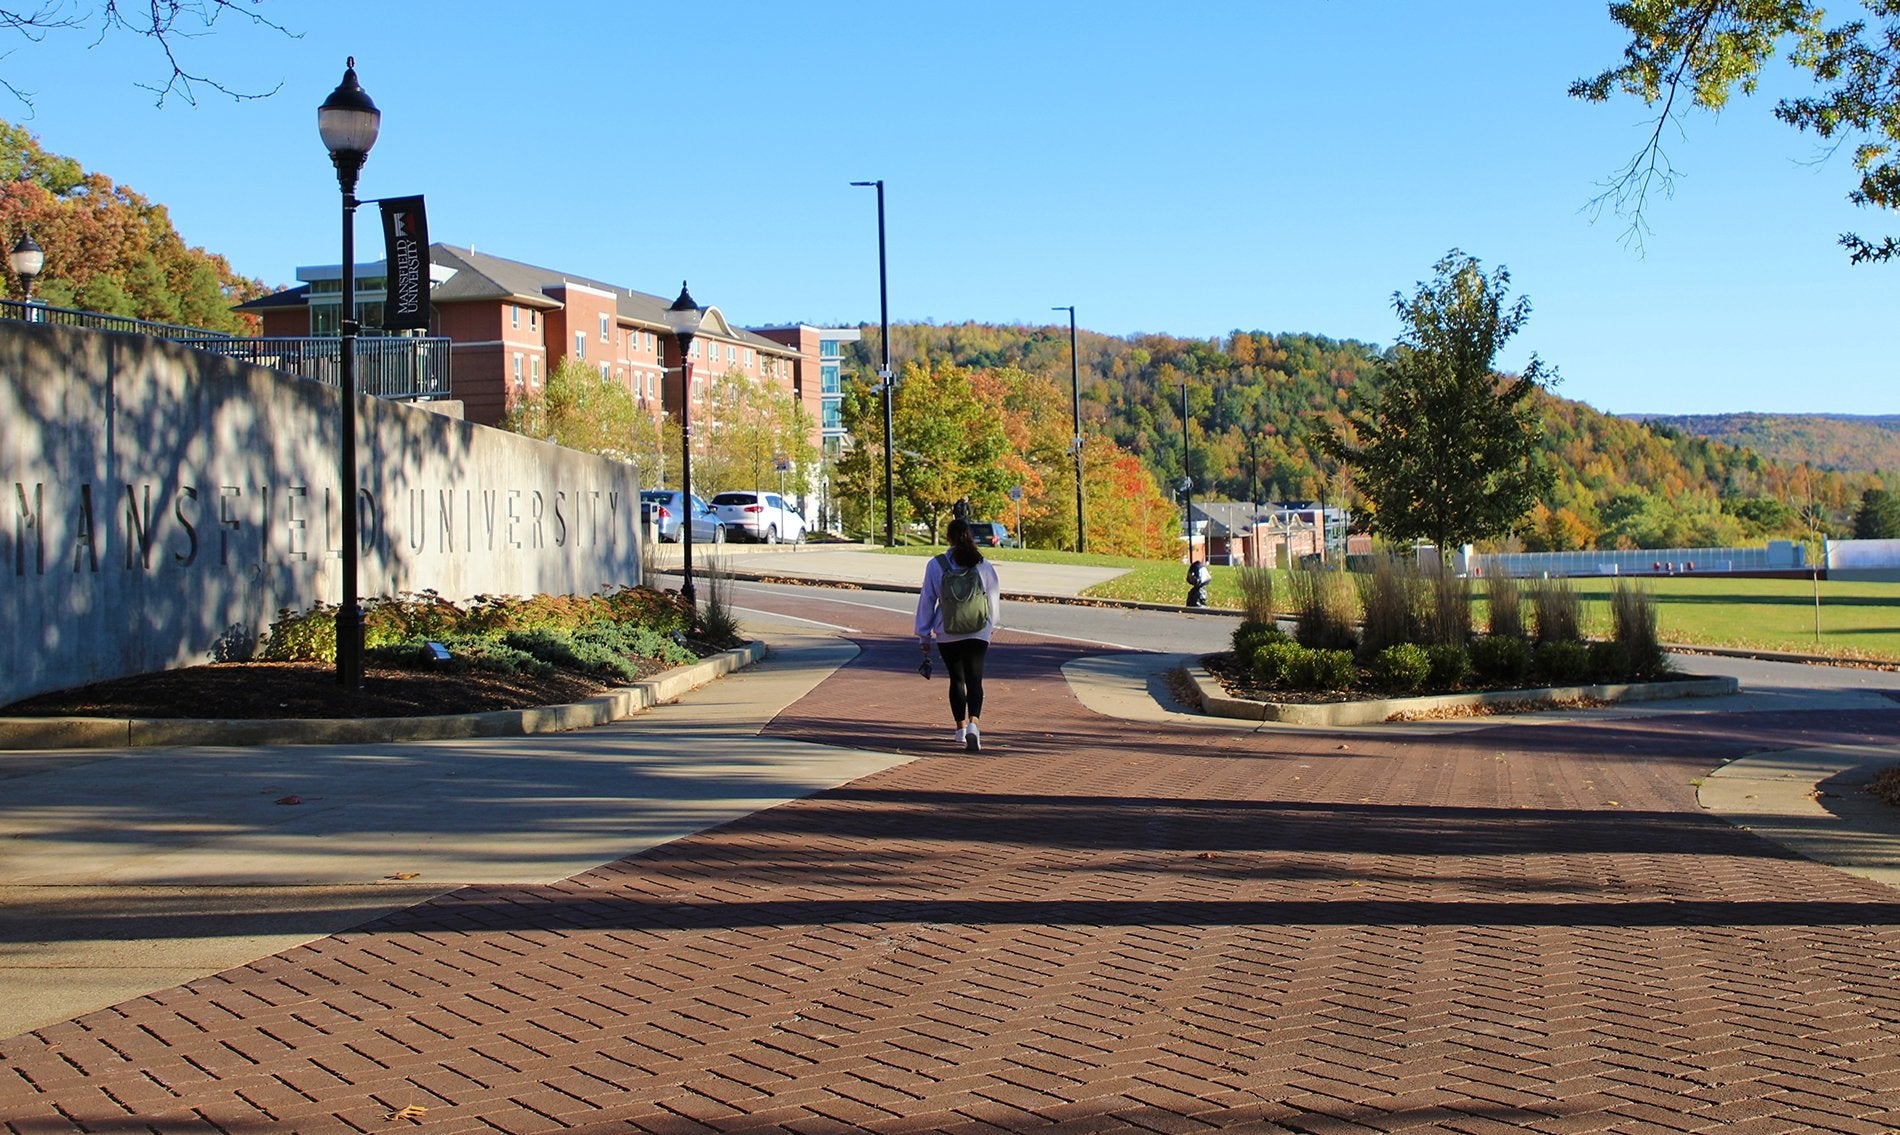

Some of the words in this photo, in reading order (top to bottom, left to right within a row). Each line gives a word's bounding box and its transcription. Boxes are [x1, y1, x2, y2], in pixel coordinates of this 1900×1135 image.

[397, 240, 408, 313] MANSFIELD
[407, 240, 419, 313] UNIVERSITY
[15, 482, 377, 576] MANSFIELD
[410, 488, 618, 555] UNIVERSITY
